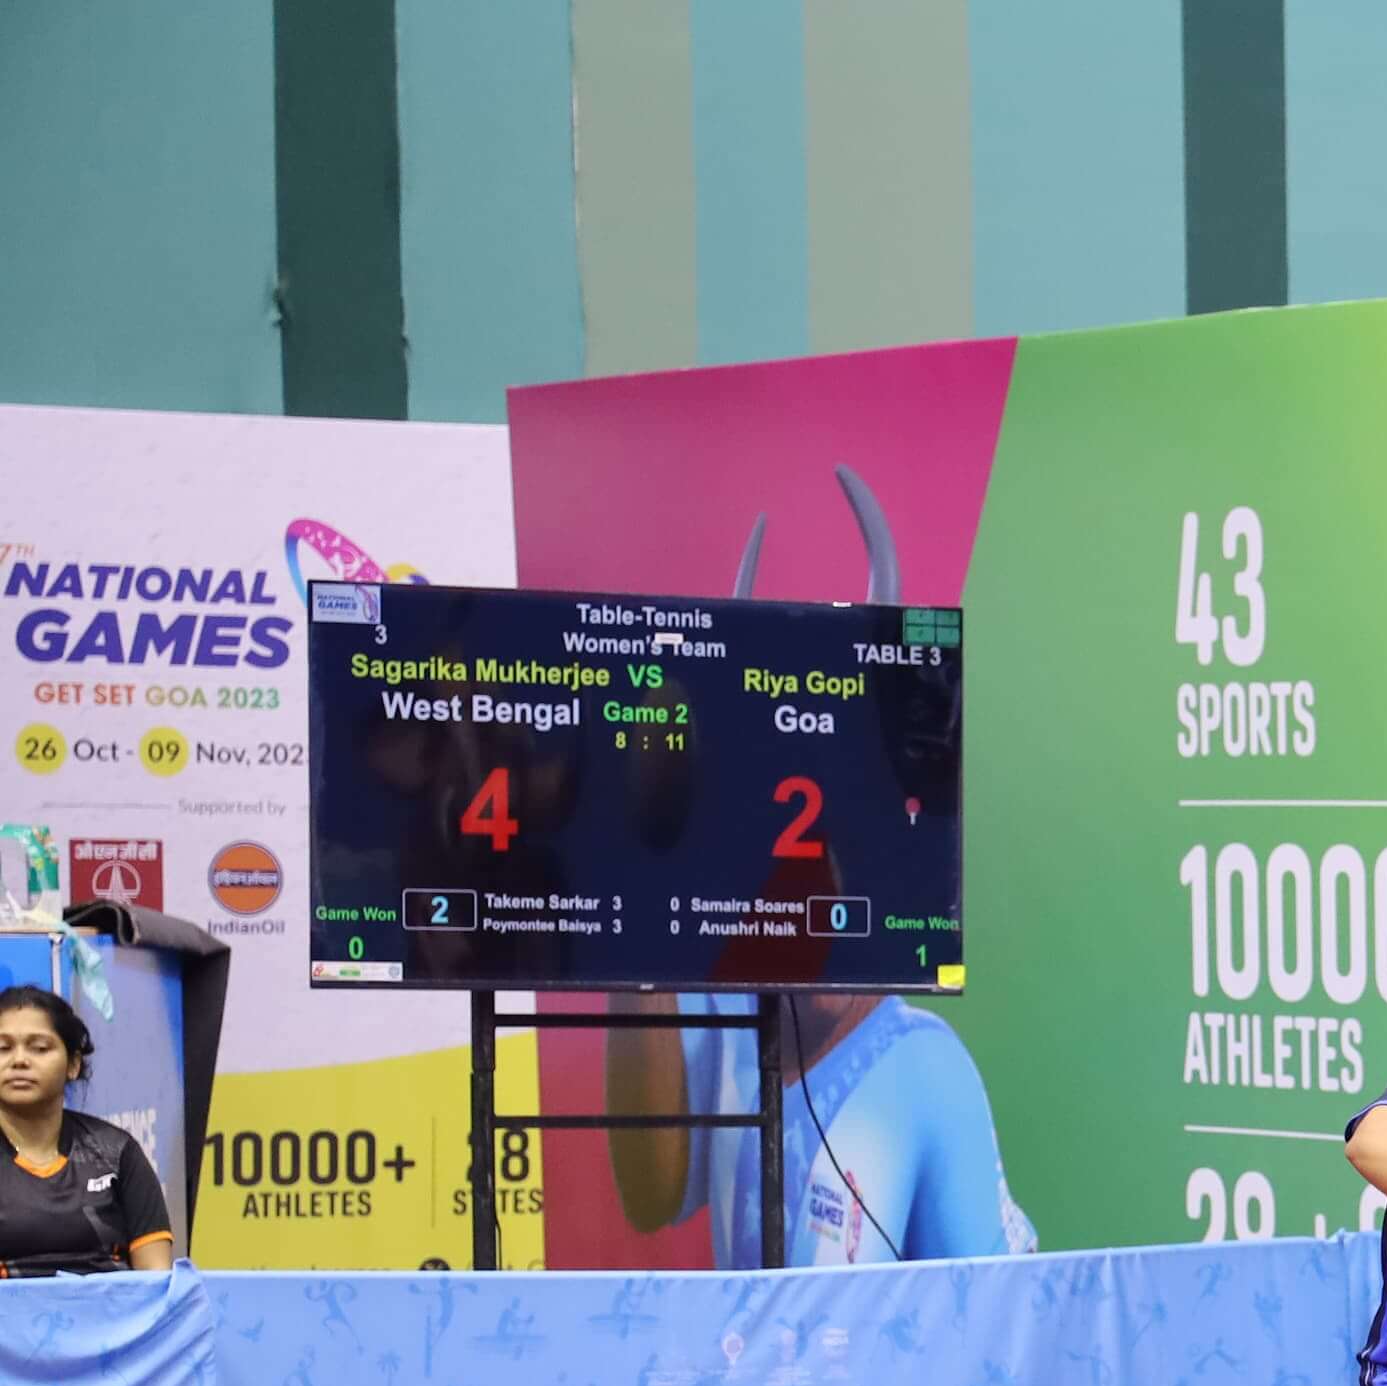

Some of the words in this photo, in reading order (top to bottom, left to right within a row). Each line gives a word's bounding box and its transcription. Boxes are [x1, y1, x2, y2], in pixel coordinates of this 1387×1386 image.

[4, 562, 277, 605] NATIONAL
[1175, 506, 1266, 666] 43
[576, 603, 713, 628] Table-Tennis
[15, 608, 293, 670] GAMES
[374, 625, 388, 644] 3
[563, 632, 663, 655] Women's
[854, 643, 923, 665] TABLE
[930, 647, 942, 665] 3
[351, 654, 467, 685] Sagarika
[476, 659, 610, 691] Mukherjee
[627, 664, 663, 688] VS
[744, 668, 798, 698] Riya
[806, 671, 865, 700] Gopi
[34, 682, 82, 706] GET
[94, 684, 134, 707] SET
[145, 685, 207, 708] GOA
[217, 686, 280, 709] 2023
[382, 691, 463, 721] West
[472, 694, 580, 732] Bengal
[603, 701, 668, 723] Game
[675, 704, 688, 724] 2
[775, 705, 835, 734] Goa
[1176, 680, 1316, 758] SPORTS
[24, 738, 58, 762] 26
[73, 738, 120, 763] Oct
[147, 741, 180, 764] 09
[196, 742, 252, 769] Nov,
[257, 743, 309, 765] 202
[615, 731, 627, 749] 8
[666, 733, 684, 750] 11
[178, 799, 260, 818] Supported
[266, 800, 286, 817] by
[460, 768, 519, 852] 4
[772, 775, 824, 858] 2
[315, 906, 359, 921] Game
[363, 907, 396, 921] Won
[431, 896, 449, 924] 2
[549, 894, 600, 910] Sarkar
[612, 895, 622, 911] 3
[670, 897, 680, 912] 0
[691, 897, 750, 913] Samaira
[754, 898, 805, 914] Soares
[208, 919, 285, 936] IndianOil
[612, 919, 622, 934] 3
[670, 920, 680, 934] 0
[699, 920, 759, 936] Anushri
[763, 921, 797, 936] Naik
[831, 904, 847, 930] 0
[885, 916, 924, 930] Game
[928, 917, 959, 931] Won
[349, 937, 364, 960] 0
[916, 945, 927, 967] 1
[1184, 1011, 1364, 1094] ATHLETES
[205, 1130, 416, 1187] 10000+
[243, 1192, 372, 1218] ATHLETES
[453, 1189, 543, 1215] STES
